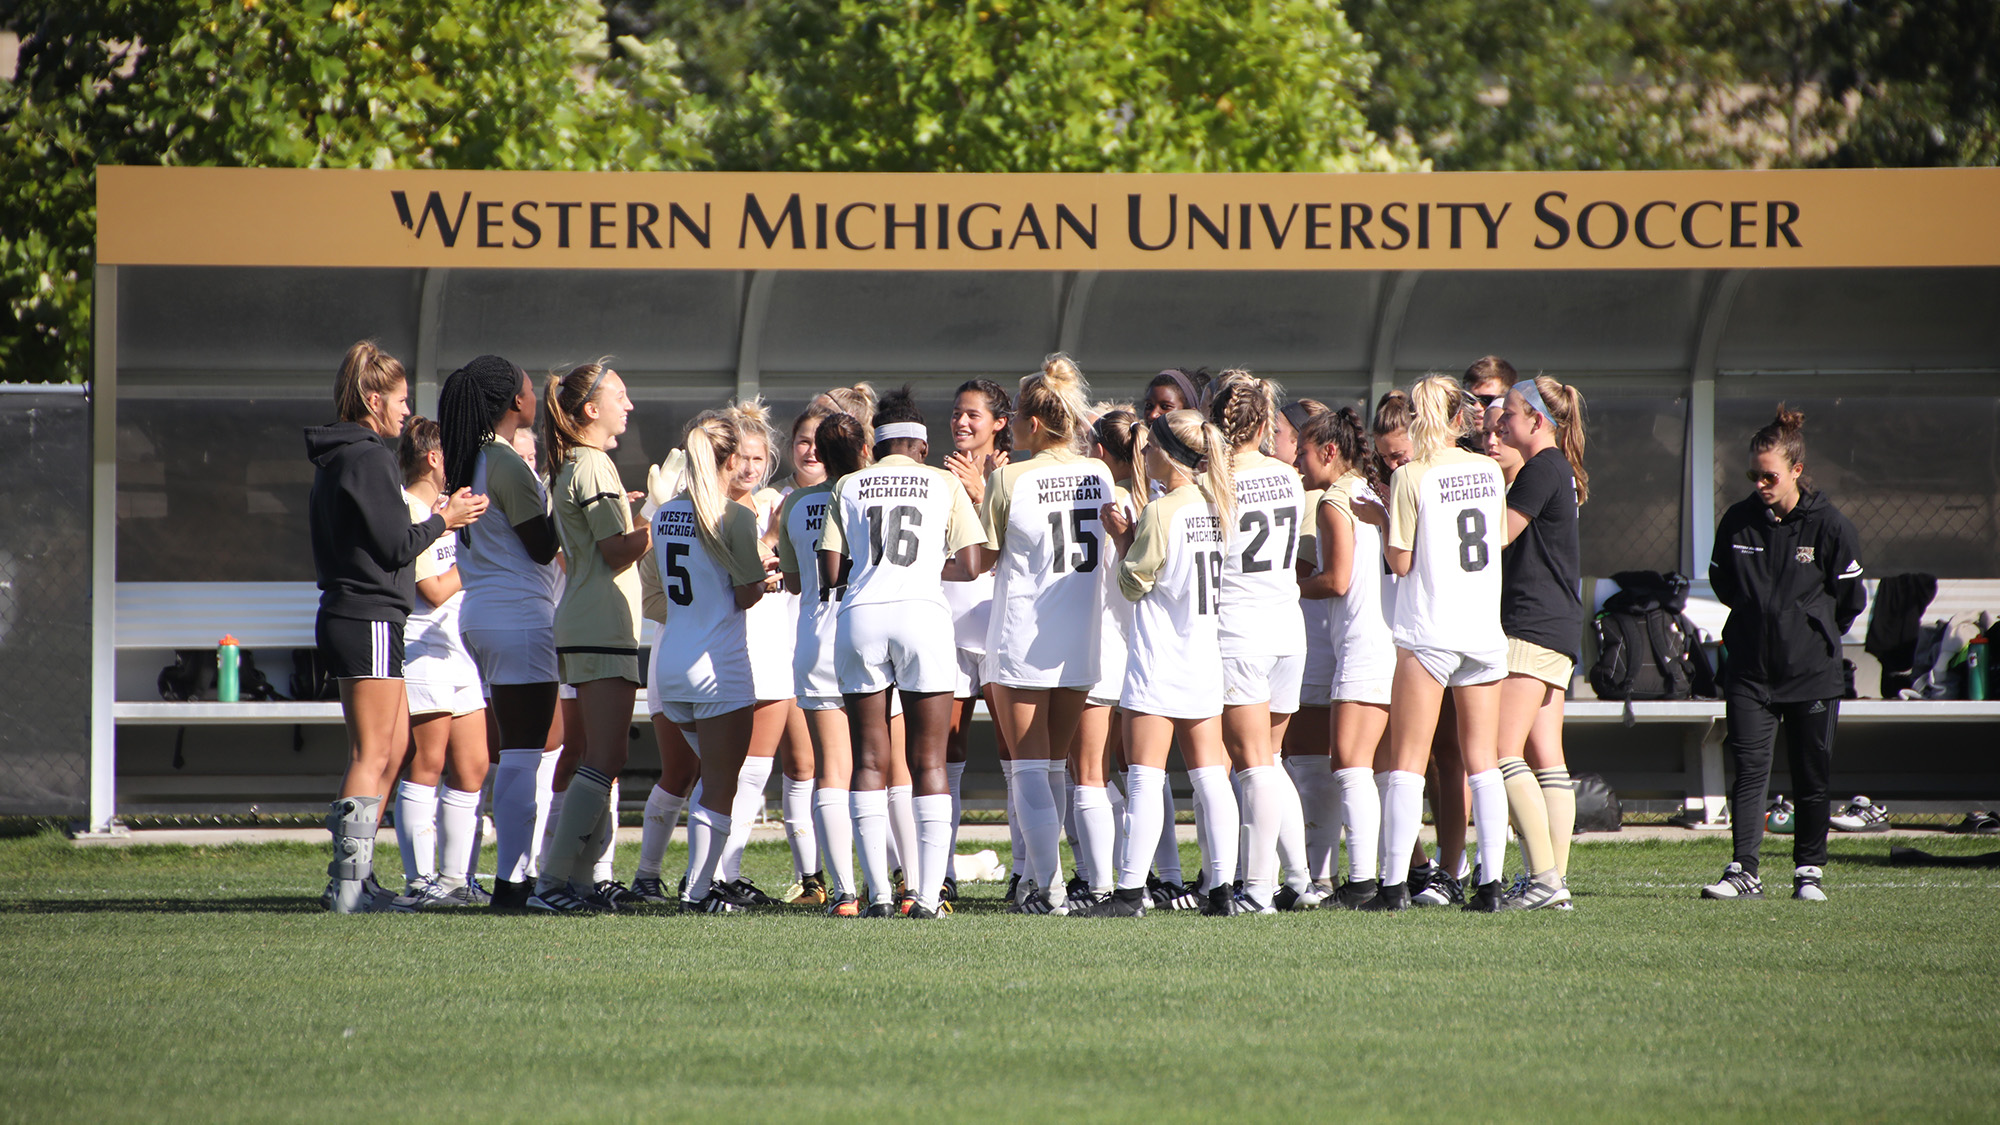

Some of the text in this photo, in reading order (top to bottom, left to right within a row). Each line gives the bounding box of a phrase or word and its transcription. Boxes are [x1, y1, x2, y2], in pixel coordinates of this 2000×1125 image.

[391, 190, 1802, 250] WESTERN MICHIGAN UNIVERSITY SOCCER
[859, 475, 929, 488] WESTERN
[1037, 474, 1101, 490] WESTERN
[1236, 473, 1291, 492] WESTERN
[1438, 472, 1495, 490] WESTERN
[858, 487, 928, 500] MICHIGAN
[1037, 487, 1102, 504] MICHIGAN
[1237, 486, 1295, 505] MICHIGAN
[1440, 485, 1497, 504] MICHIGAN
[660, 511, 694, 523] WESTE
[657, 524, 697, 538] MICHIGA
[866, 505, 923, 567] 16
[1047, 507, 1099, 573] 15
[1186, 530, 1223, 543] MICHIGA
[1239, 505, 1298, 574] 27
[1456, 507, 1489, 573] 8
[666, 542, 693, 606] 5
[1195, 550, 1223, 615] 19
